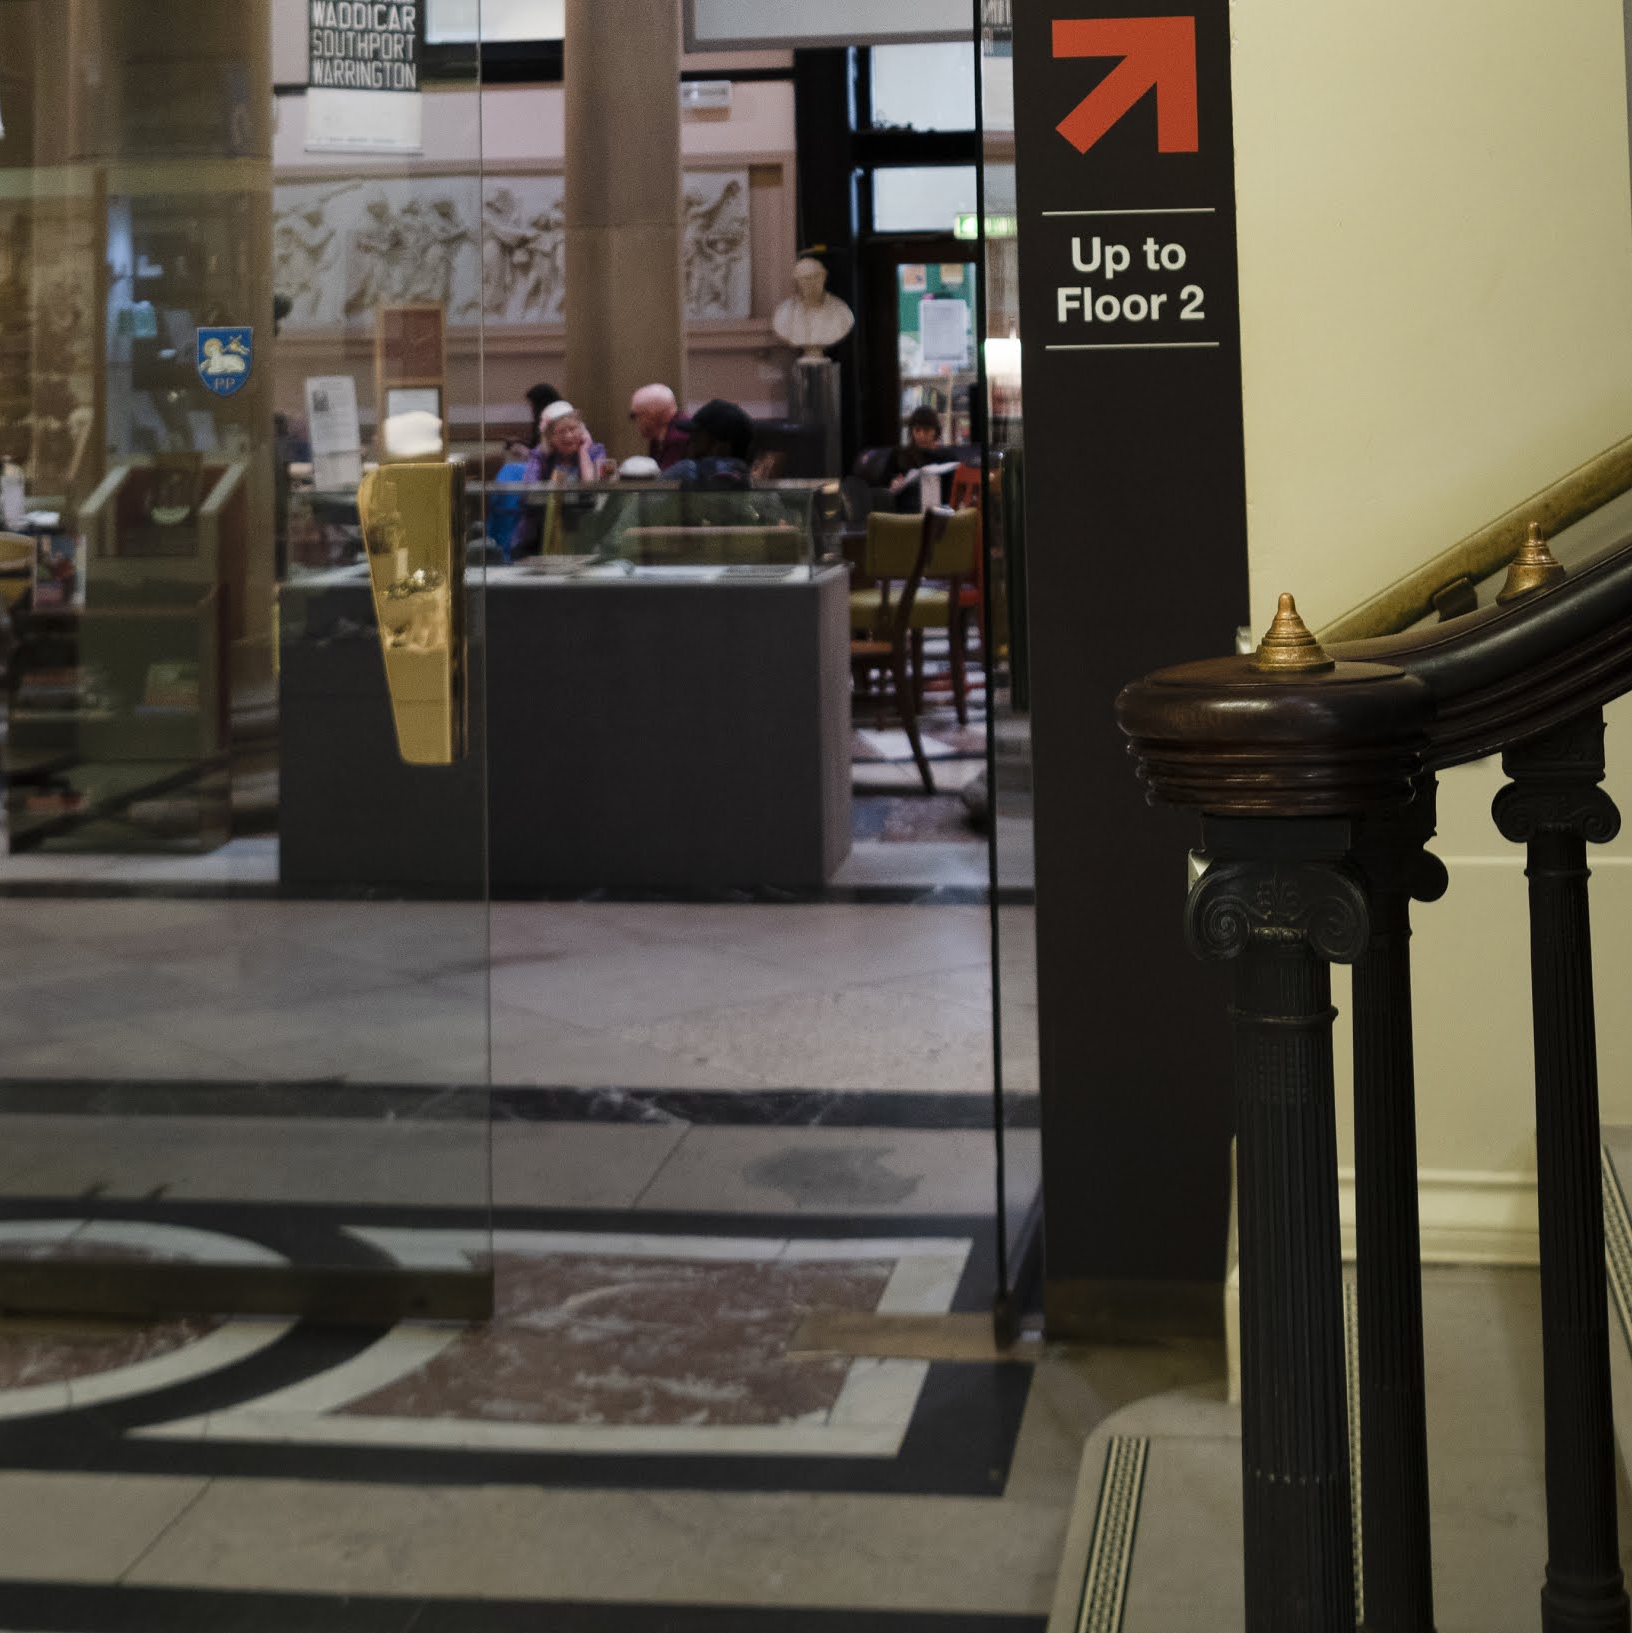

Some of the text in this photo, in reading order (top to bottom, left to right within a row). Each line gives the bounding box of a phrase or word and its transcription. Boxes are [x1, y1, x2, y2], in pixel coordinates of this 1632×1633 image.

[312, 0, 416, 32] WADDICAR
[312, 29, 416, 60] SOUTHPORT
[312, 58, 416, 89] WARRINGTON
[1071, 236, 1187, 279] Up to
[1056, 284, 1206, 323] Floor 2
